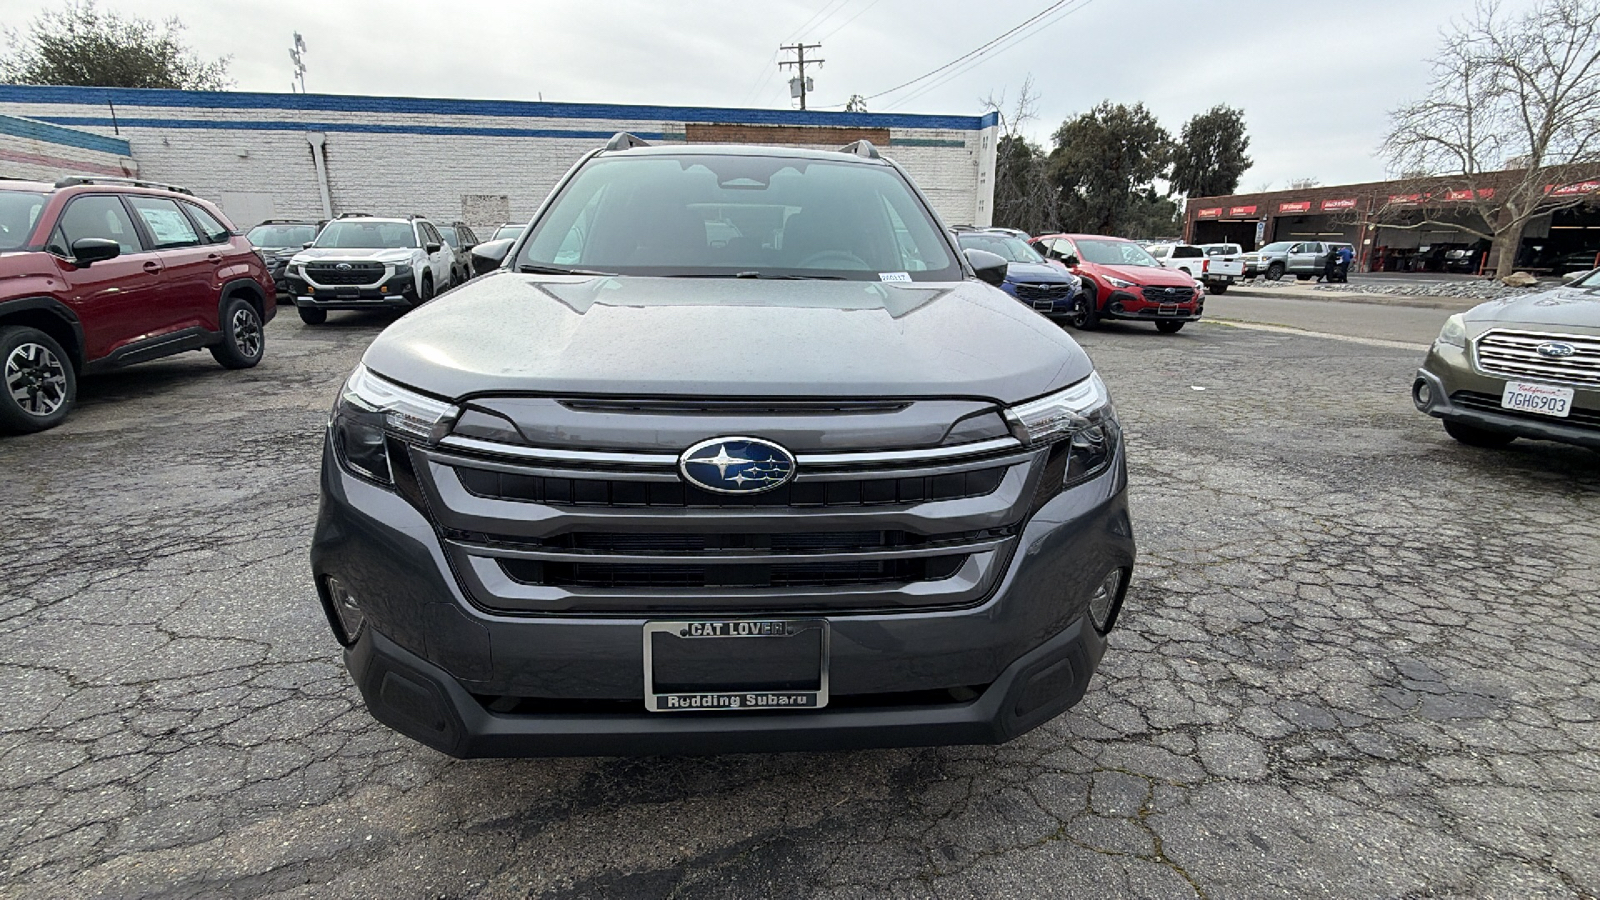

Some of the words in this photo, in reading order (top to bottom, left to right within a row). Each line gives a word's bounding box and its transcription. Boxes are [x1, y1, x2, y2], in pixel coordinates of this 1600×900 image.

[1508, 391, 1566, 412] 7GHG903
[691, 622, 723, 636] CAT
[729, 621, 783, 635] LOVER
[667, 695, 740, 708] Redding
[745, 694, 807, 706] Subaru
